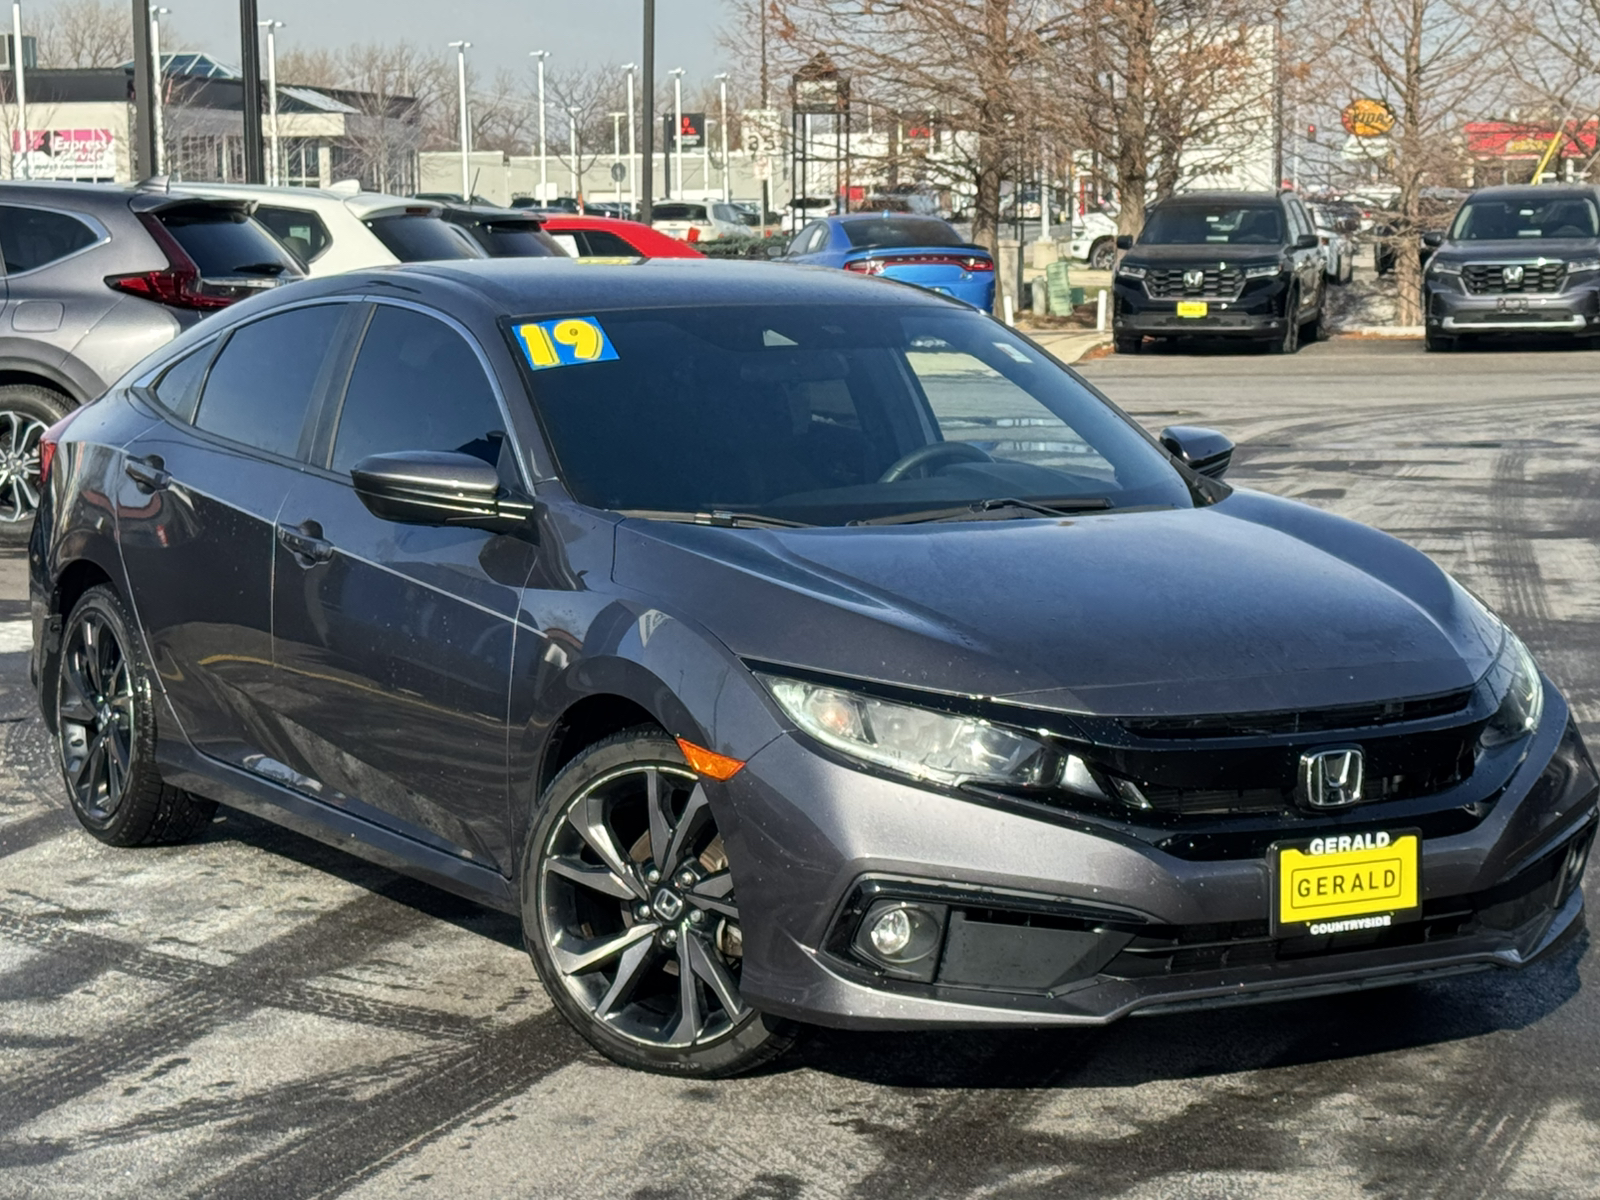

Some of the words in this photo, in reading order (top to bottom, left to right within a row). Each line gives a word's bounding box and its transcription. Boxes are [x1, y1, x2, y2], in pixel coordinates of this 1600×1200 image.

[54, 135, 108, 154] Express
[520, 319, 604, 366] 19
[1309, 831, 1391, 856] GERALD
[1297, 869, 1396, 898] GERALD
[1309, 915, 1392, 936] COUNTRYSIDE
